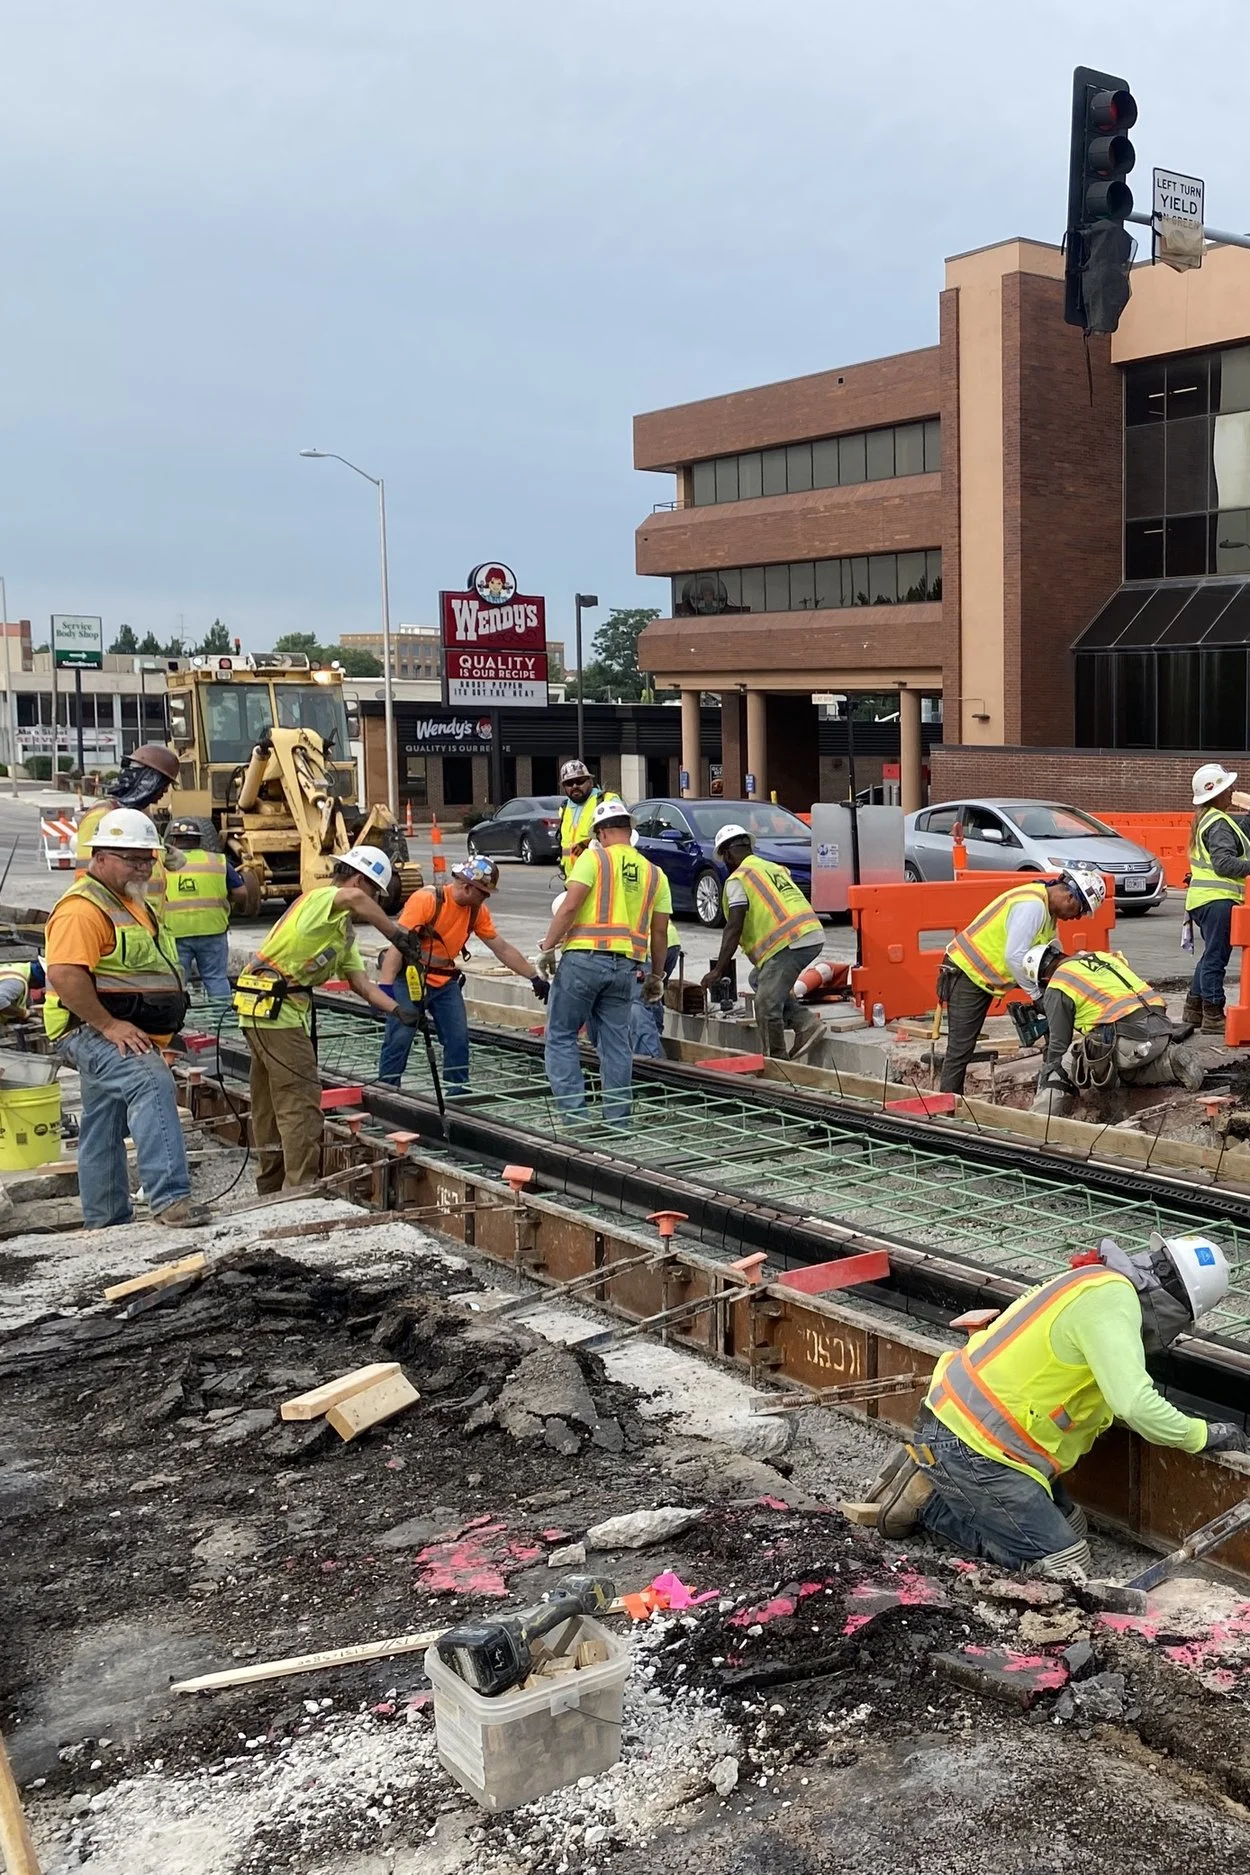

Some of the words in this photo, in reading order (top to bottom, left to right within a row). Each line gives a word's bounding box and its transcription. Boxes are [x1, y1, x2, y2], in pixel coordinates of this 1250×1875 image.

[1157, 178, 1177, 192] LEFT
[1180, 183, 1201, 198] TURN
[1160, 193, 1198, 215] YIELD
[62, 621, 92, 631] Service
[451, 599, 538, 641] Wendy's
[56, 629, 76, 640] Body
[79, 630, 99, 641] Shop
[459, 655, 536, 670] QUALITY
[460, 669, 469, 677] IS
[472, 669, 495, 678] OUR
[498, 670, 536, 679] RECIPE
[416, 716, 473, 740] Wendy's
[405, 744, 446, 753] QUALITY
